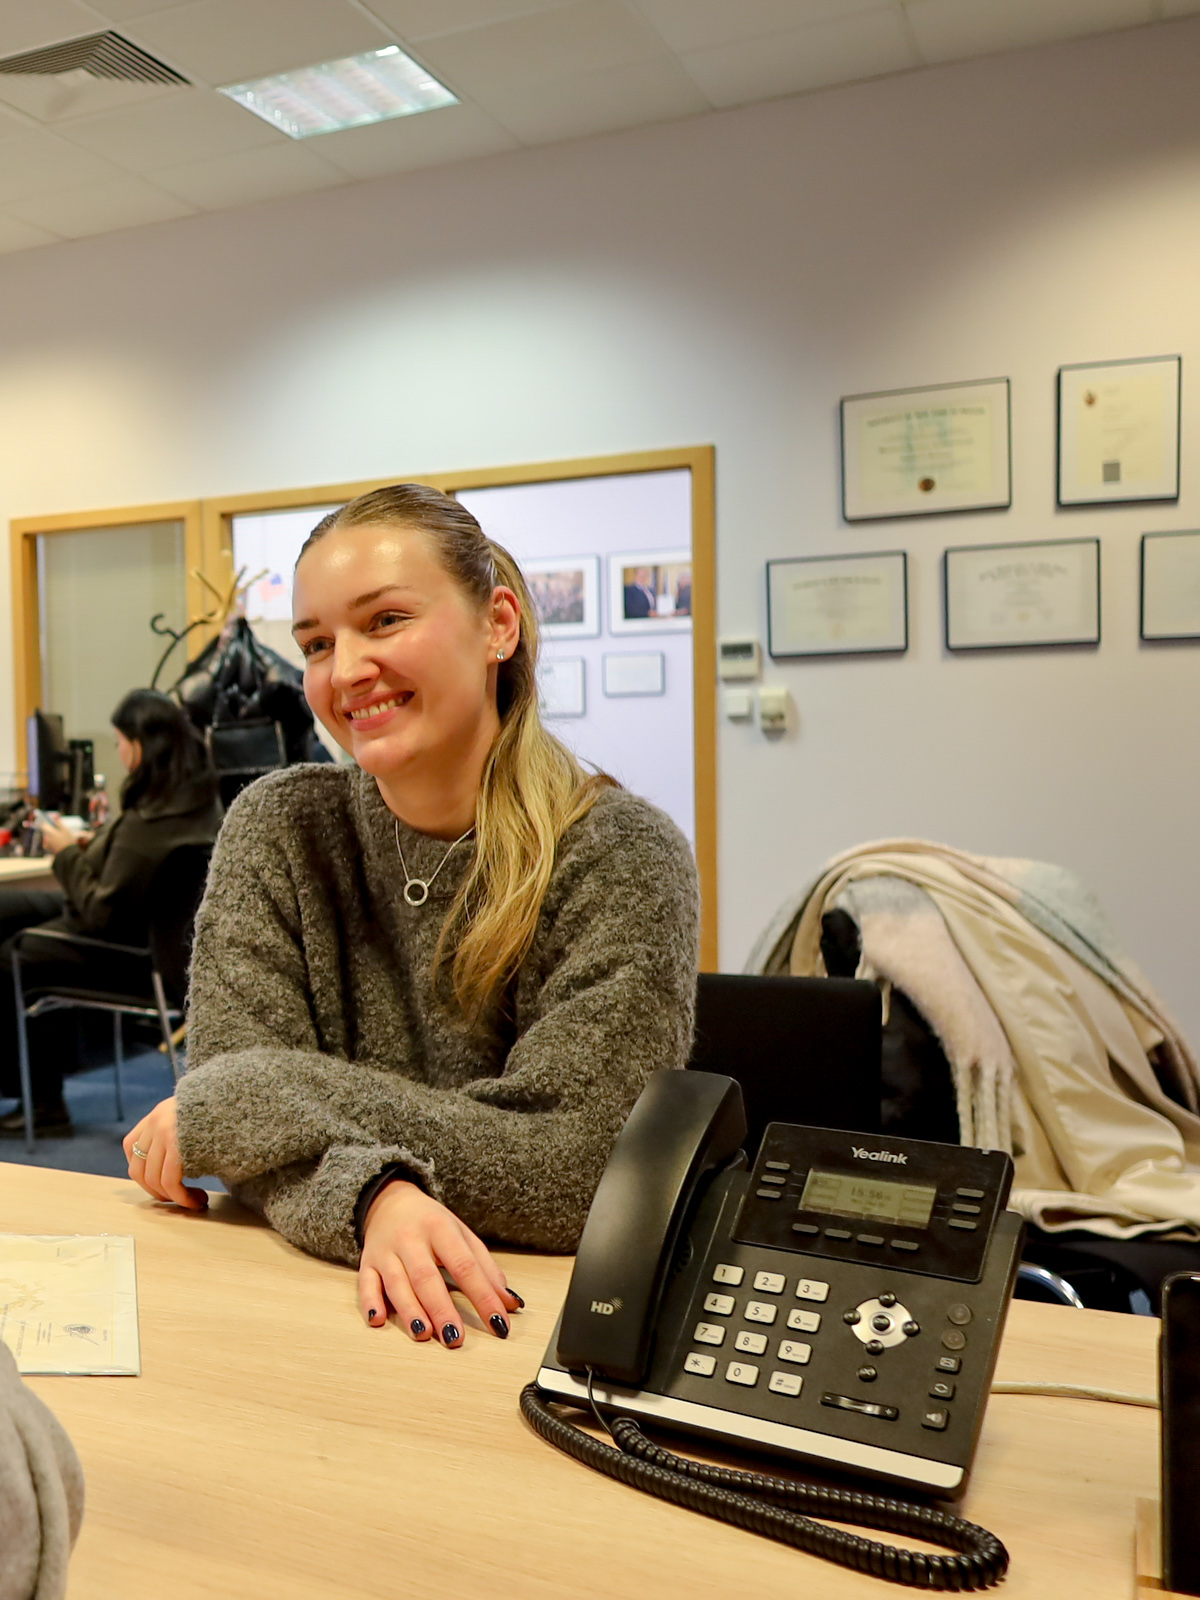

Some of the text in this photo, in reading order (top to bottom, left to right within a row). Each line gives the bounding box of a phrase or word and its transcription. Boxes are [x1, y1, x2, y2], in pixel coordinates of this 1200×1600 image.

[851, 1146, 908, 1165] Yealink
[721, 1268, 726, 1278] 1
[761, 1276, 770, 1286] 2
[802, 1284, 811, 1294] 3
[590, 1300, 614, 1315] HD
[710, 1298, 718, 1307] 4
[752, 1306, 760, 1316] 5
[793, 1315, 802, 1325] 6
[700, 1327, 709, 1336] 7
[742, 1336, 750, 1346] 8
[784, 1345, 793, 1355] 9
[733, 1367, 741, 1377] 0
